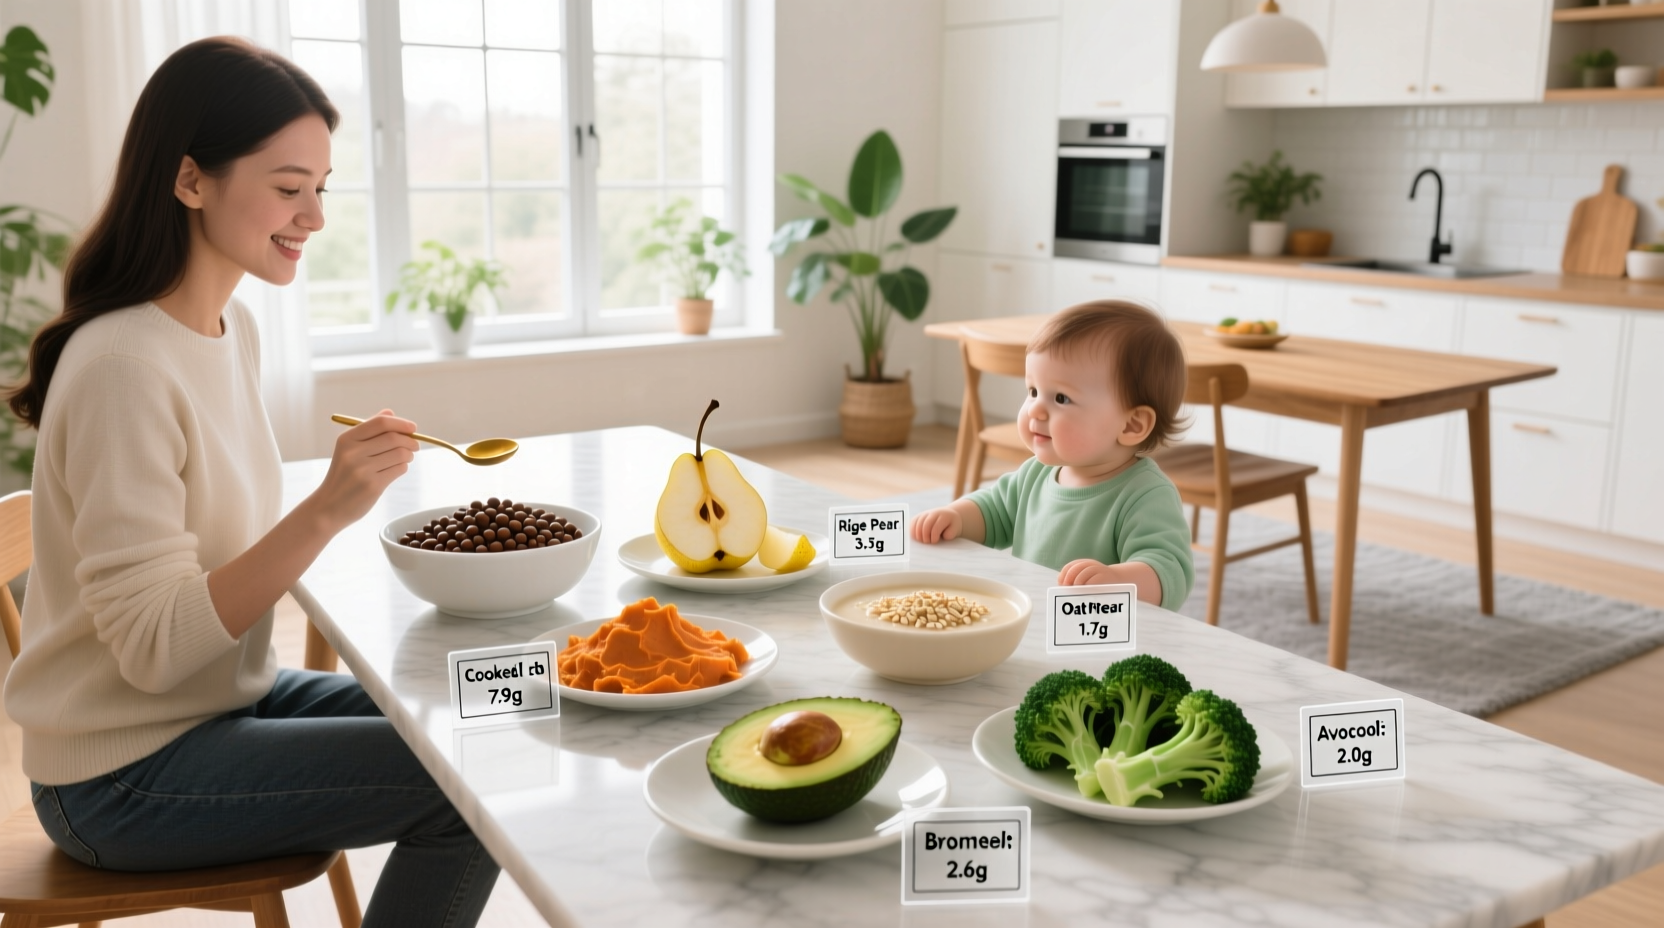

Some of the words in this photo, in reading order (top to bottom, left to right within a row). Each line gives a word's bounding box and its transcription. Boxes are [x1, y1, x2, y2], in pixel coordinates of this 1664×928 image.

[839, 518, 867, 535] Rige
[870, 518, 899, 531] Pear
[855, 537, 884, 552] 3.5g
[1078, 621, 1108, 639] 1.7g
[488, 687, 522, 706] 7.9g
[1337, 746, 1372, 766] 2.0g
[946, 860, 988, 883] 2.6g
